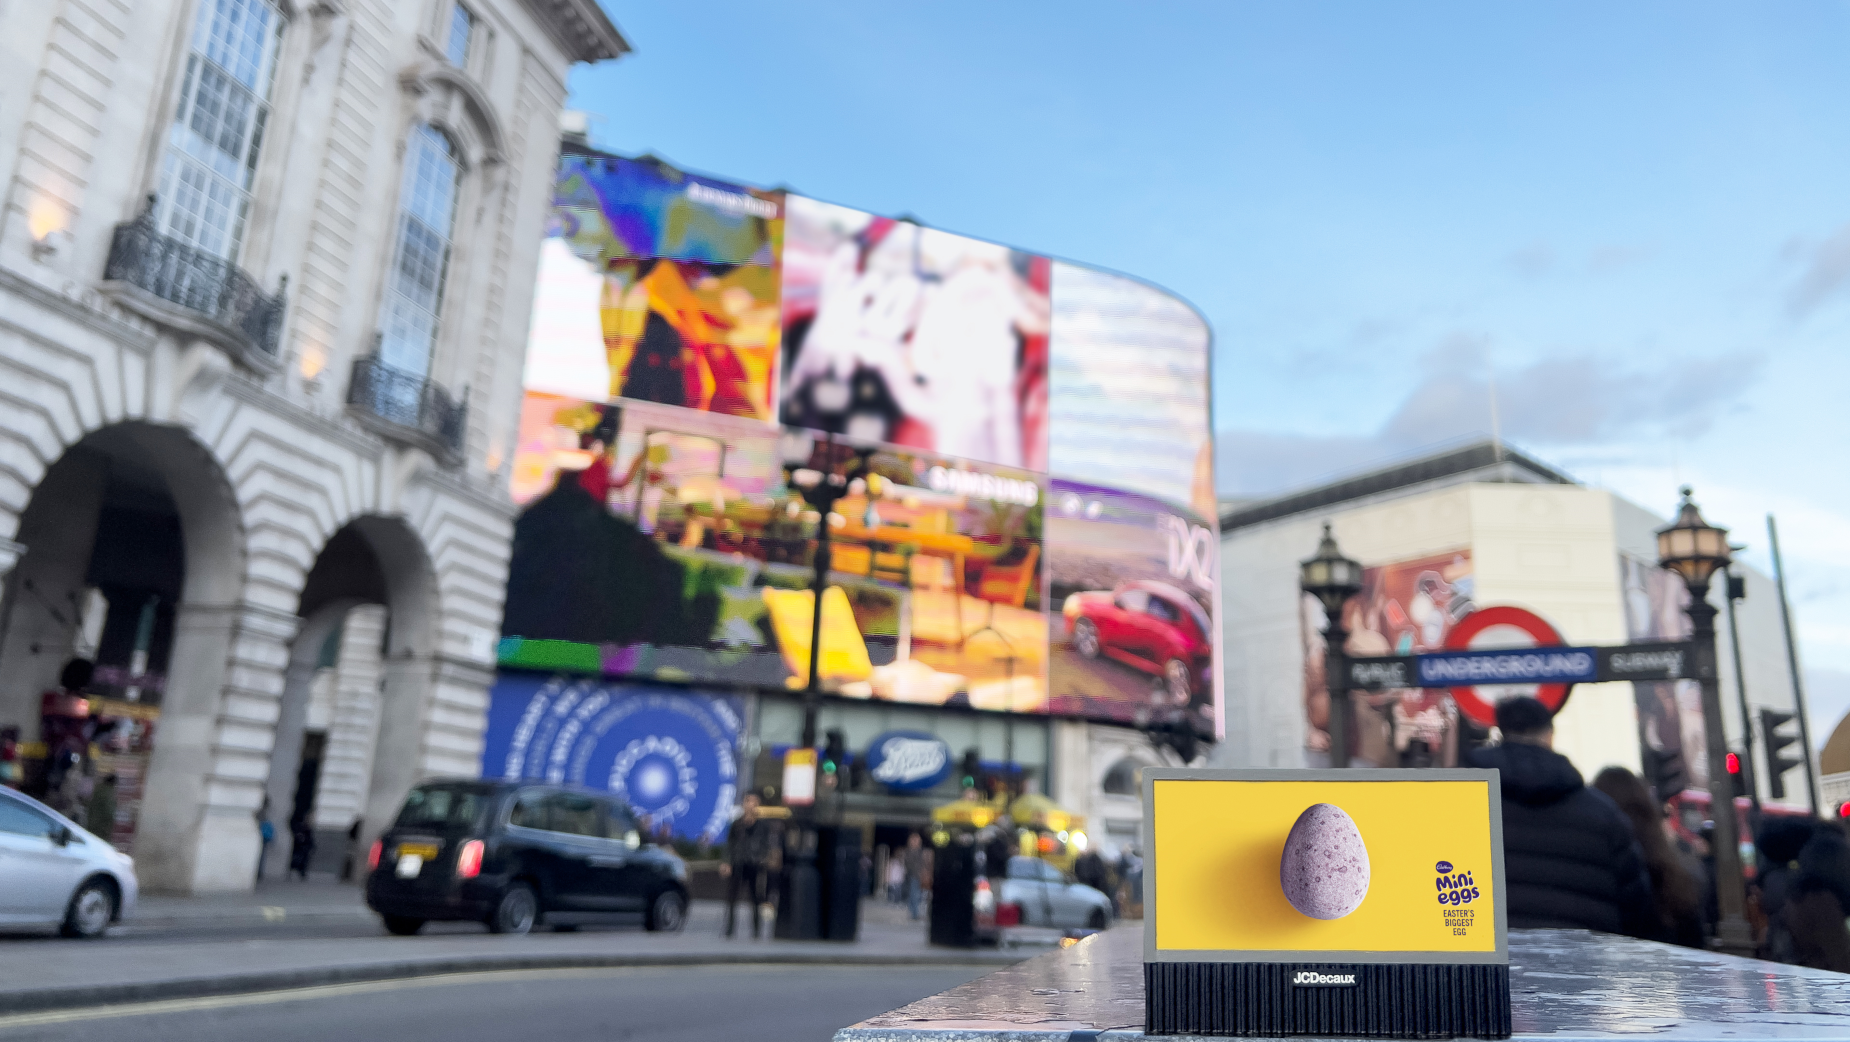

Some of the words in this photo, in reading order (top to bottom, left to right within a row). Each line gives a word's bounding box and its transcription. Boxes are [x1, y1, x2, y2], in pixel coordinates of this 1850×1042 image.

[928, 465, 1038, 507] SAMSUNG
[1421, 651, 1593, 681] UNDERGROUND
[1435, 870, 1475, 892] Mini
[1437, 886, 1481, 907] eggs
[1443, 909, 1475, 918] EASTER'S
[1444, 918, 1474, 927] BIGGEST
[1453, 927, 1467, 936] EGG
[1293, 971, 1356, 984] JCDecaux
